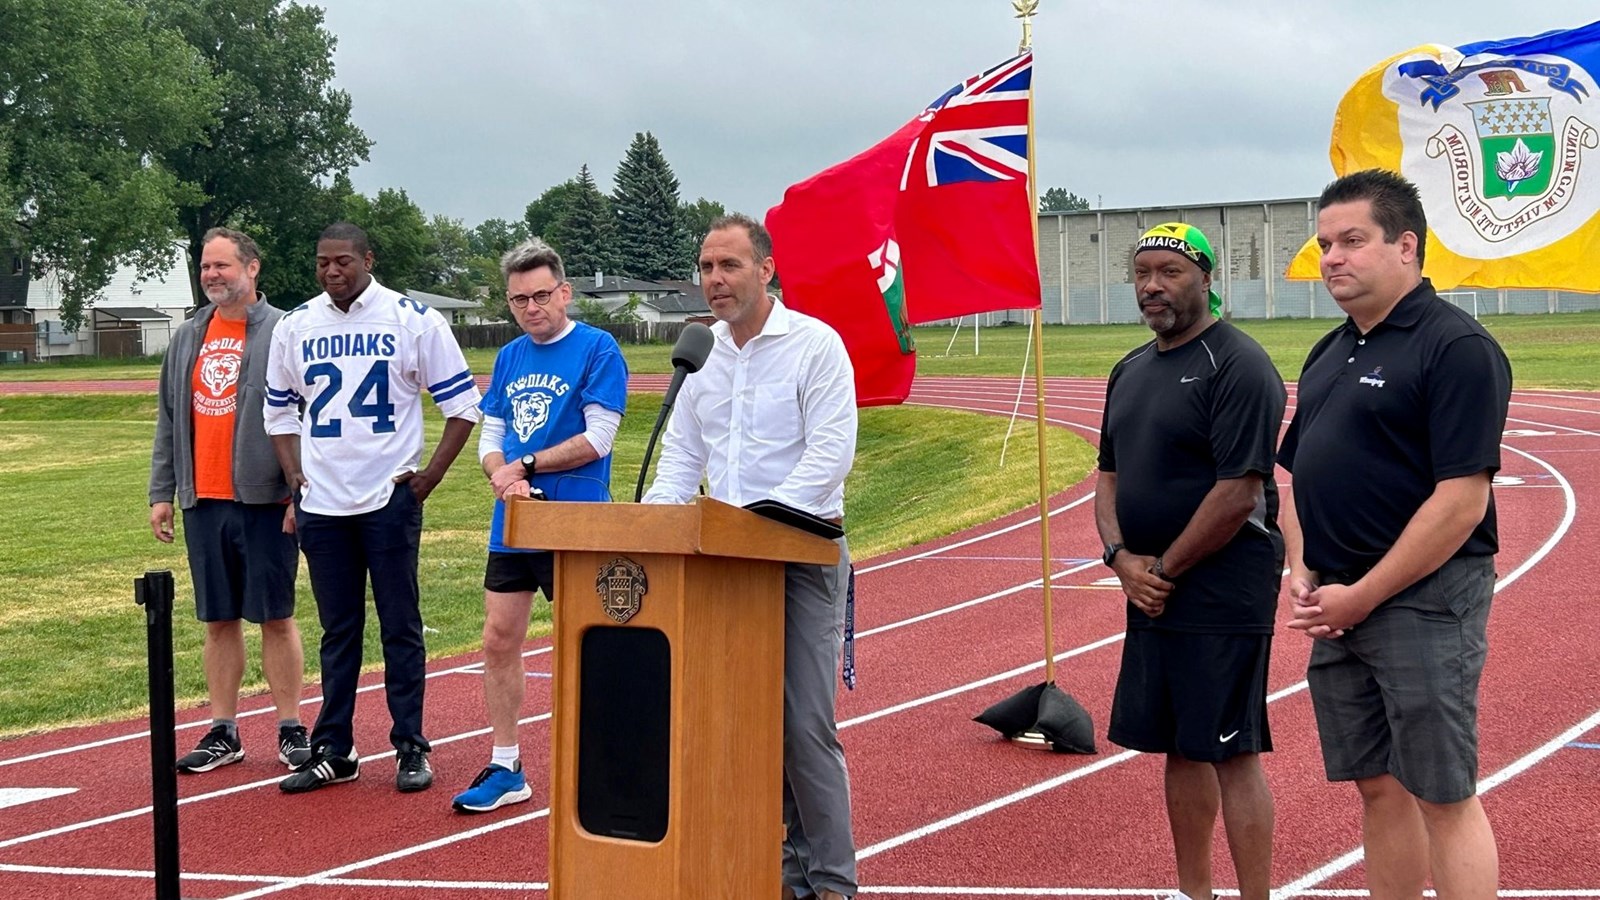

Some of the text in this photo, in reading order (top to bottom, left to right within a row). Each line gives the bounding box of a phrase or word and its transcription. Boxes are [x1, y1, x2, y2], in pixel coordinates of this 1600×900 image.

[200, 337, 244, 357] KODIA
[302, 333, 396, 363] KODIAKS
[304, 360, 396, 438] 24
